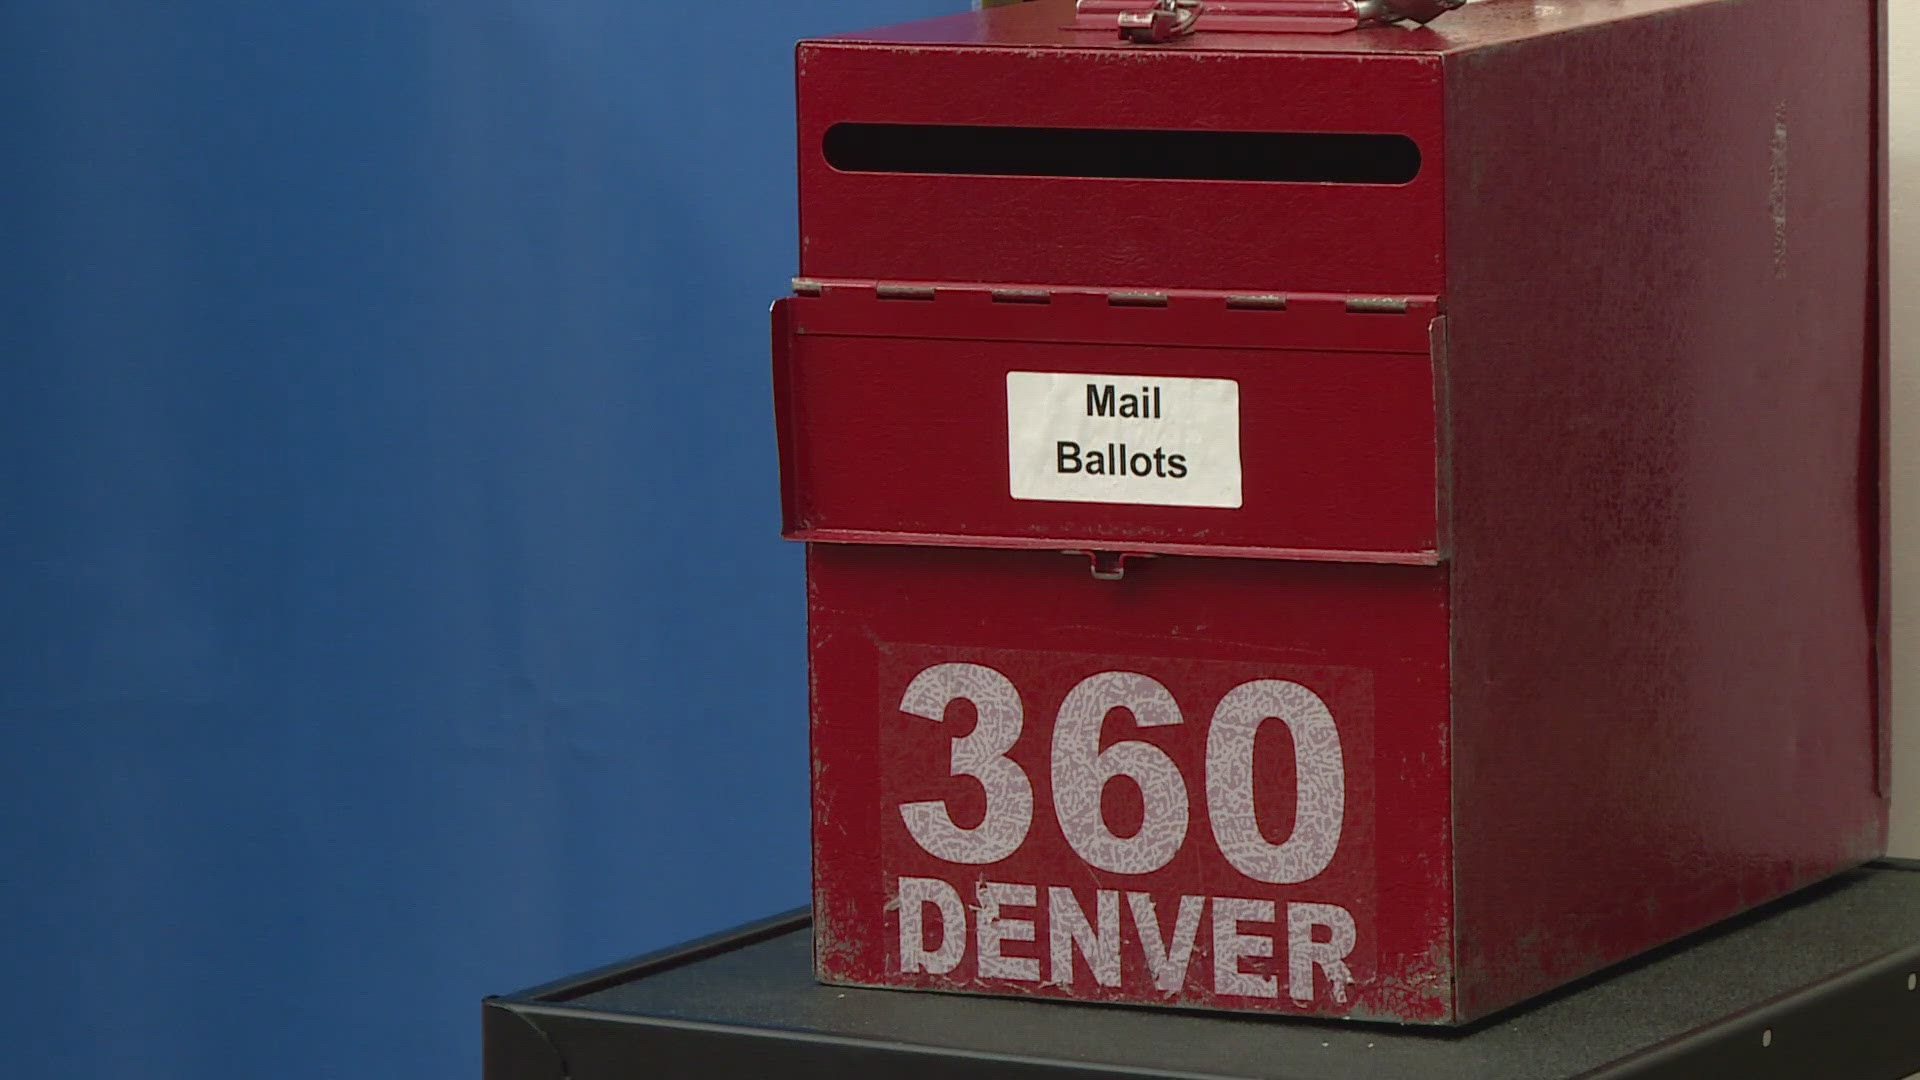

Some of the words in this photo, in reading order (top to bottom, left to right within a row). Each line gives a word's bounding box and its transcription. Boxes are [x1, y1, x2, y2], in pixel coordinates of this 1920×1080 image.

[1086, 384, 1161, 419] Mail
[1057, 441, 1187, 478] Ballots
[899, 662, 1345, 884] 360
[898, 876, 1357, 1003] DENVER
